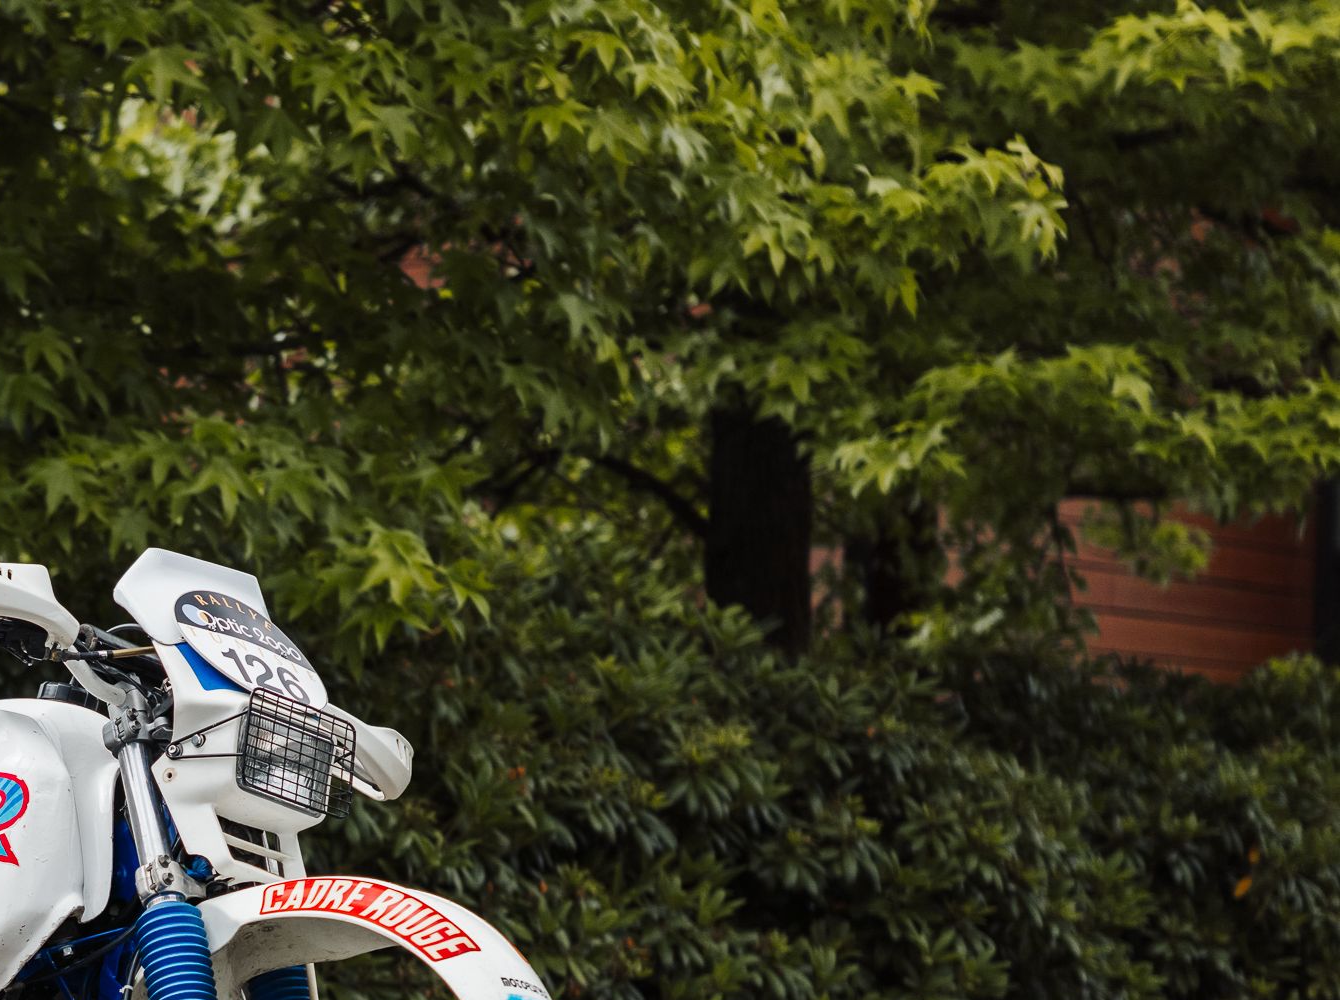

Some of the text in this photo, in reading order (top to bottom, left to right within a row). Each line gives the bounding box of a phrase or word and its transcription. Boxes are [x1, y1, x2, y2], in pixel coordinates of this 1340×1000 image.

[194, 594, 273, 632] RALLYE
[197, 609, 303, 661] Optic 2000
[221, 647, 311, 704] 126
[262, 879, 478, 960] CADRE ROUGE
